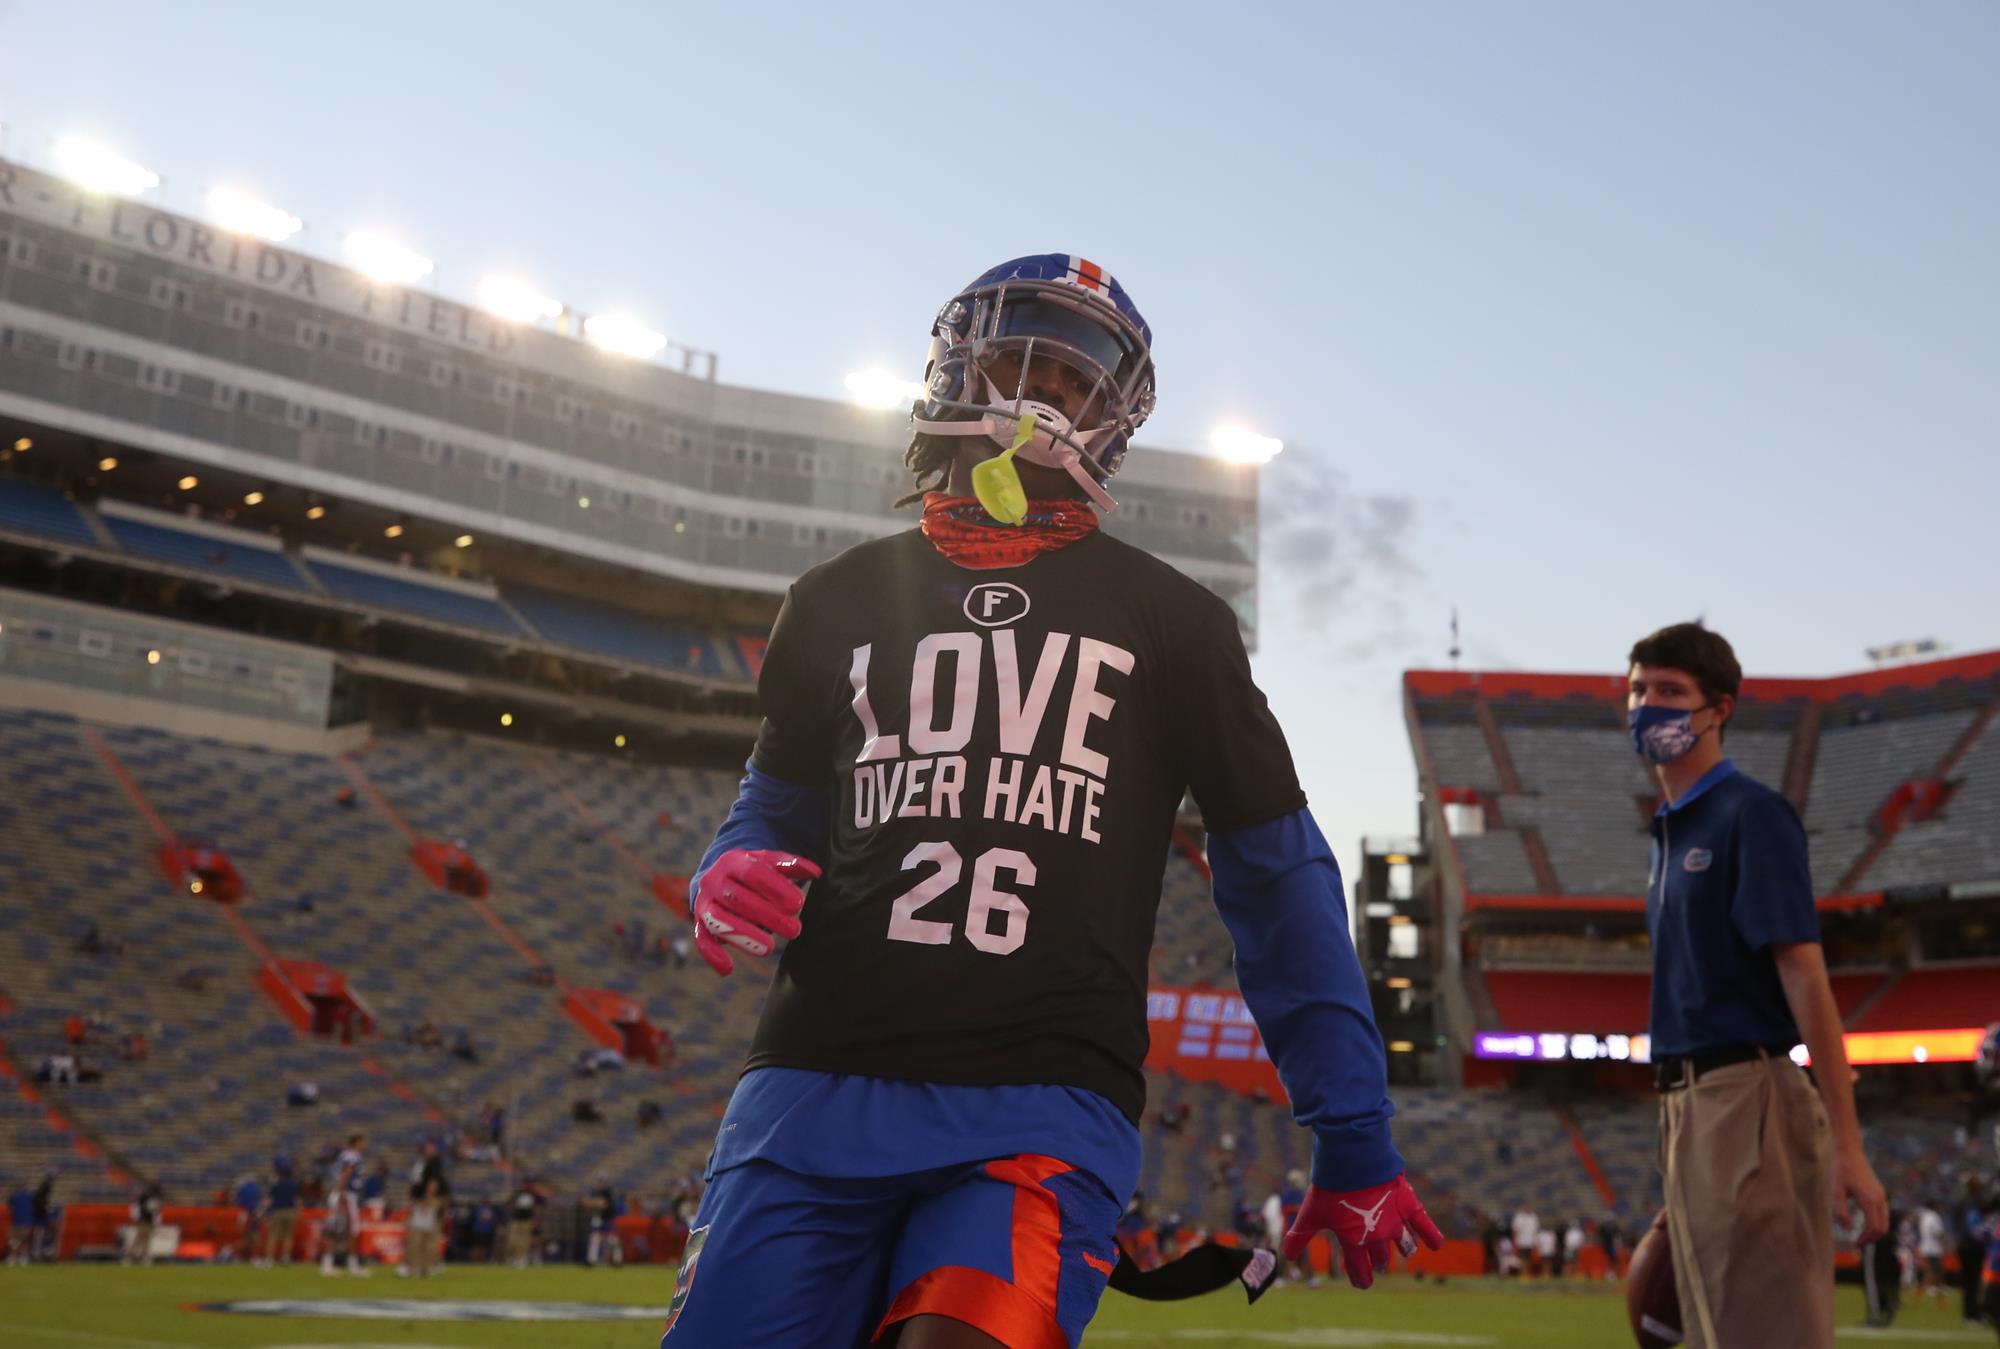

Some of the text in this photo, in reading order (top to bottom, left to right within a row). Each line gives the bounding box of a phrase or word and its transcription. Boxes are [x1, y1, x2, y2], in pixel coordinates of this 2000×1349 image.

[982, 590, 1010, 617] F
[848, 628, 1136, 780] LOVE
[853, 755, 1106, 845] OVER HATE
[886, 840, 1038, 956] 26
